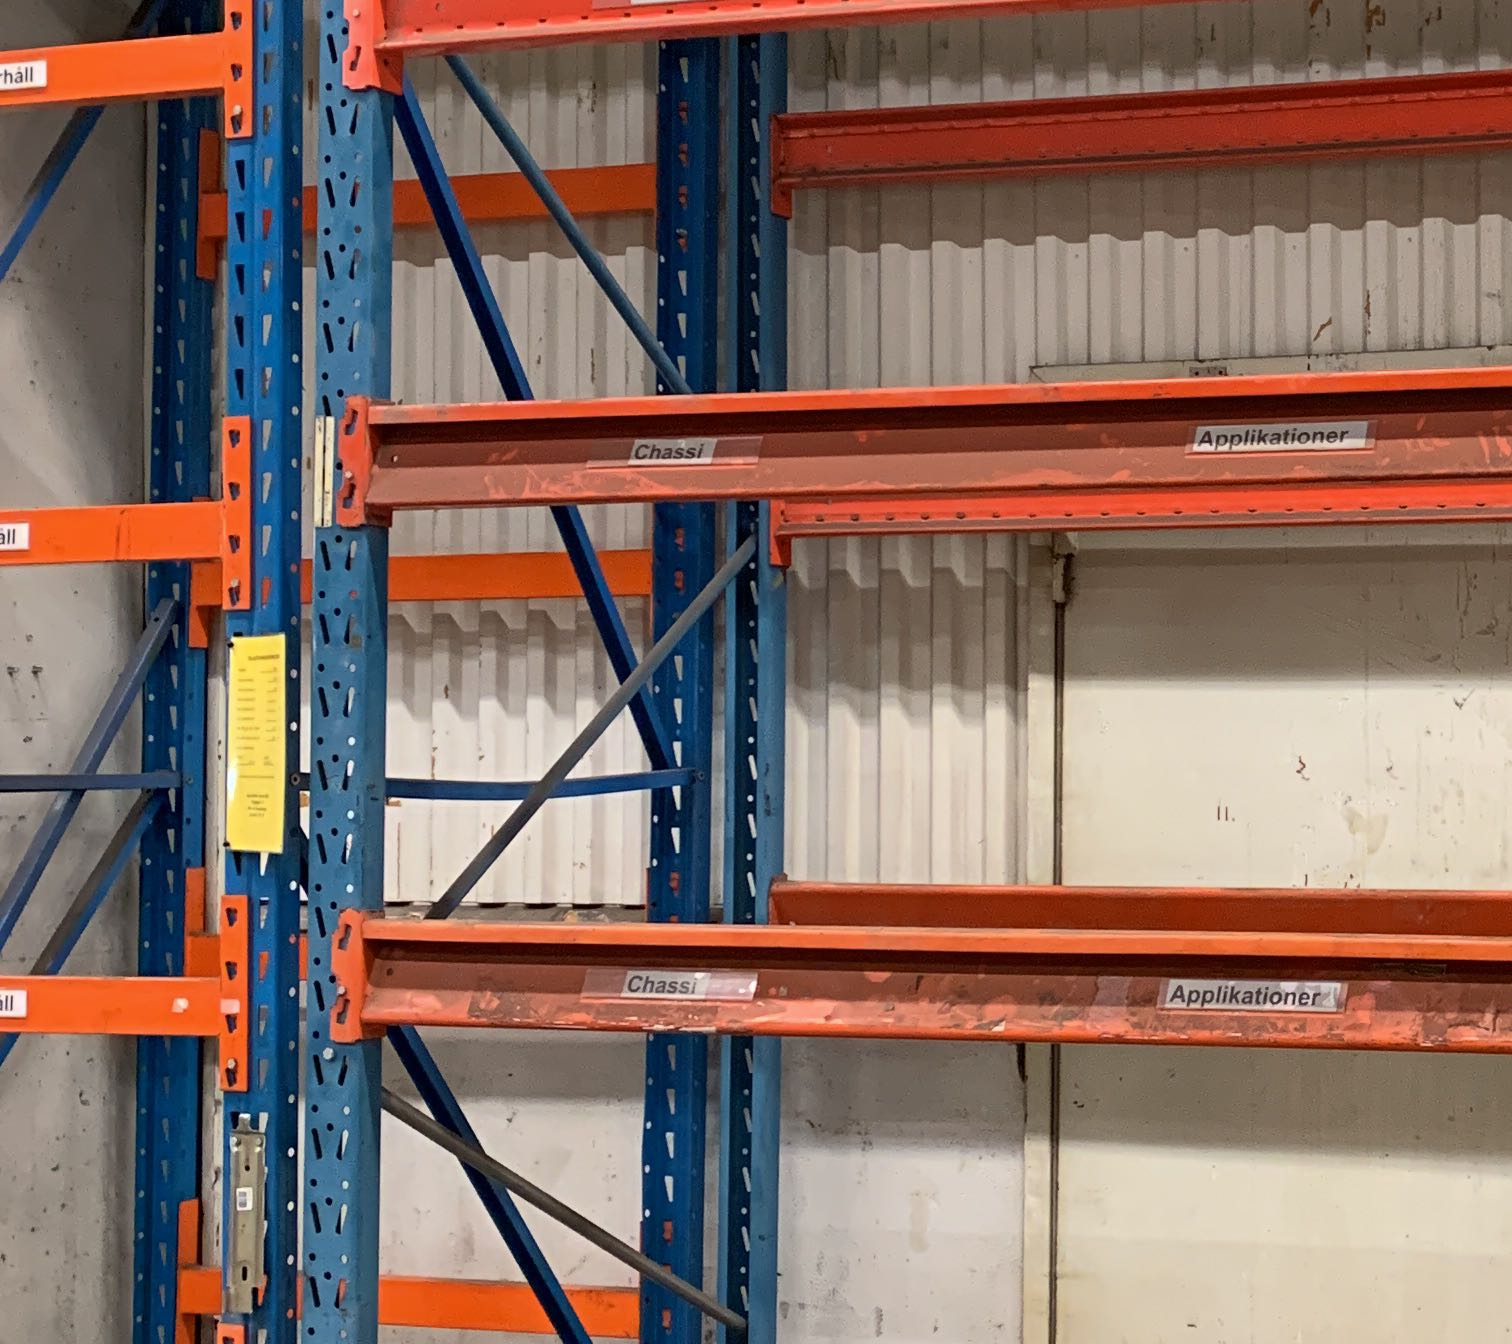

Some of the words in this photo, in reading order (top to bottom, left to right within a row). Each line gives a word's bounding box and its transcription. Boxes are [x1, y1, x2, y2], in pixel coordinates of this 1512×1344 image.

[1197, 425, 1351, 450] Applikationer
[634, 442, 705, 462] Chassi
[626, 974, 698, 995] Chassi
[1169, 983, 1322, 1010] Applikationer
